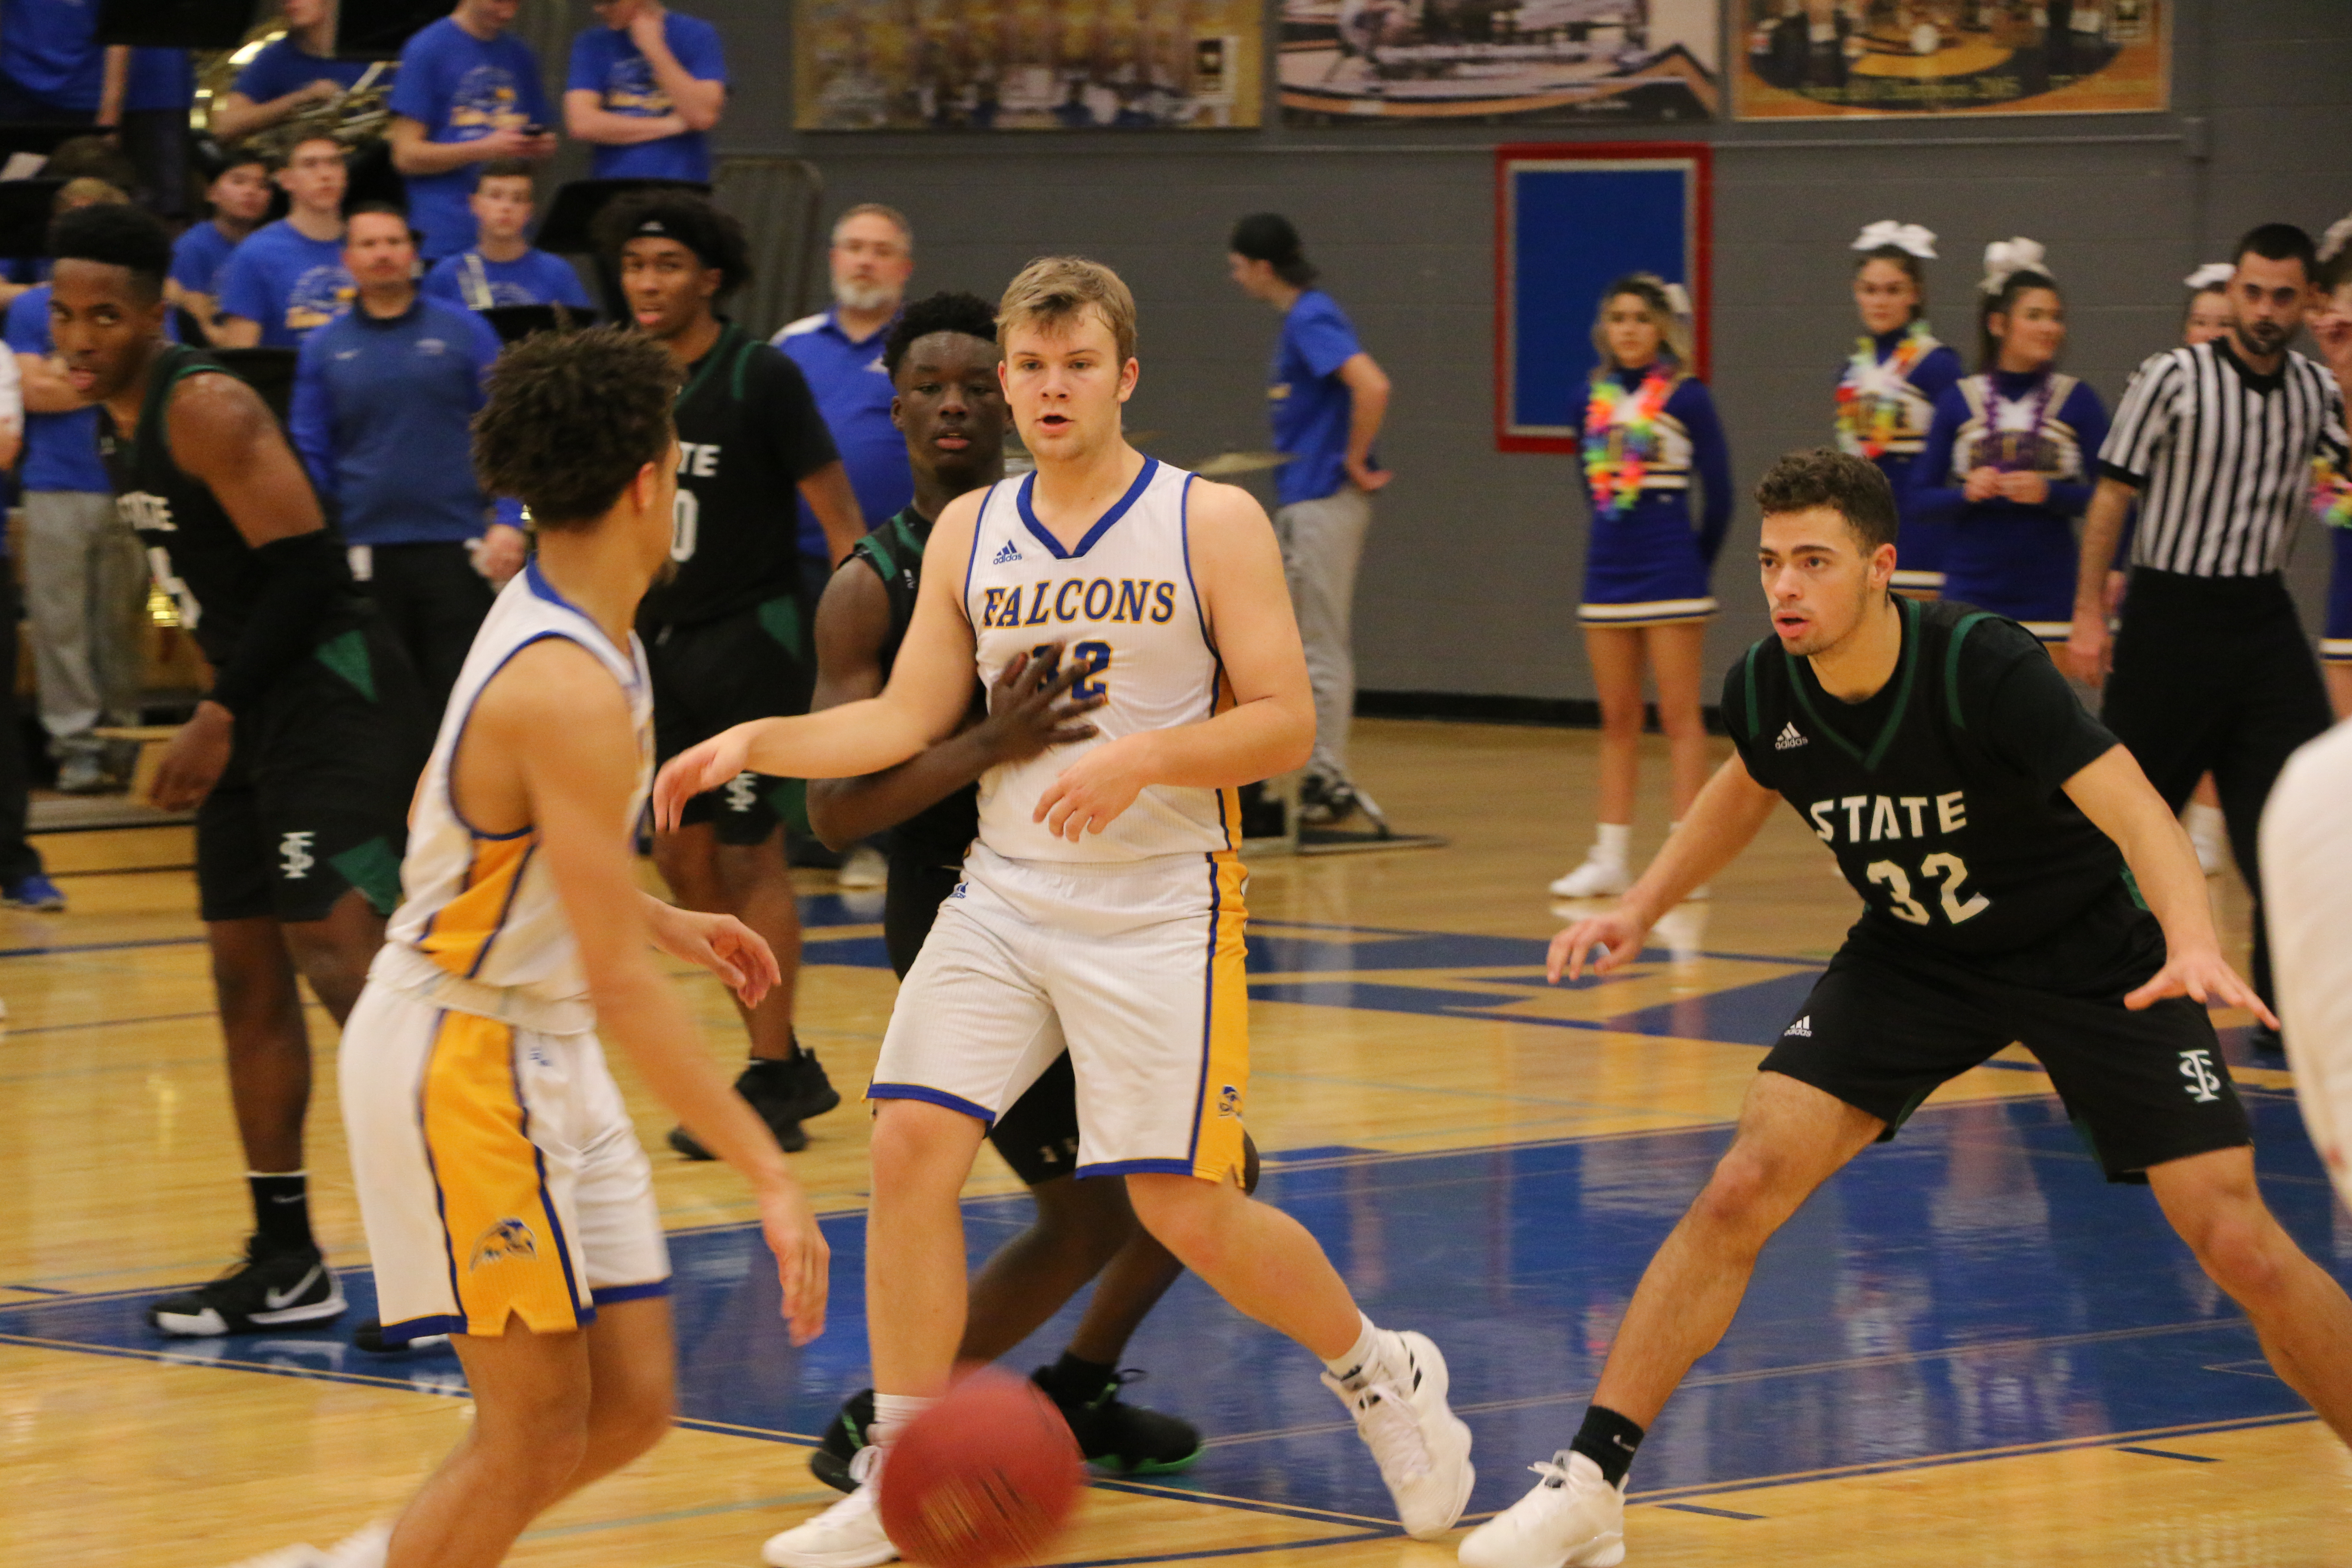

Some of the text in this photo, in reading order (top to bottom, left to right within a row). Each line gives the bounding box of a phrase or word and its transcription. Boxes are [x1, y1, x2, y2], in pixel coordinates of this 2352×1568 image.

[993, 553, 1022, 565] adidas
[983, 576, 1177, 629] FALCONS
[1775, 736, 1808, 750] adidas
[1810, 790, 1967, 843] STATE
[1866, 852, 1991, 926] 32
